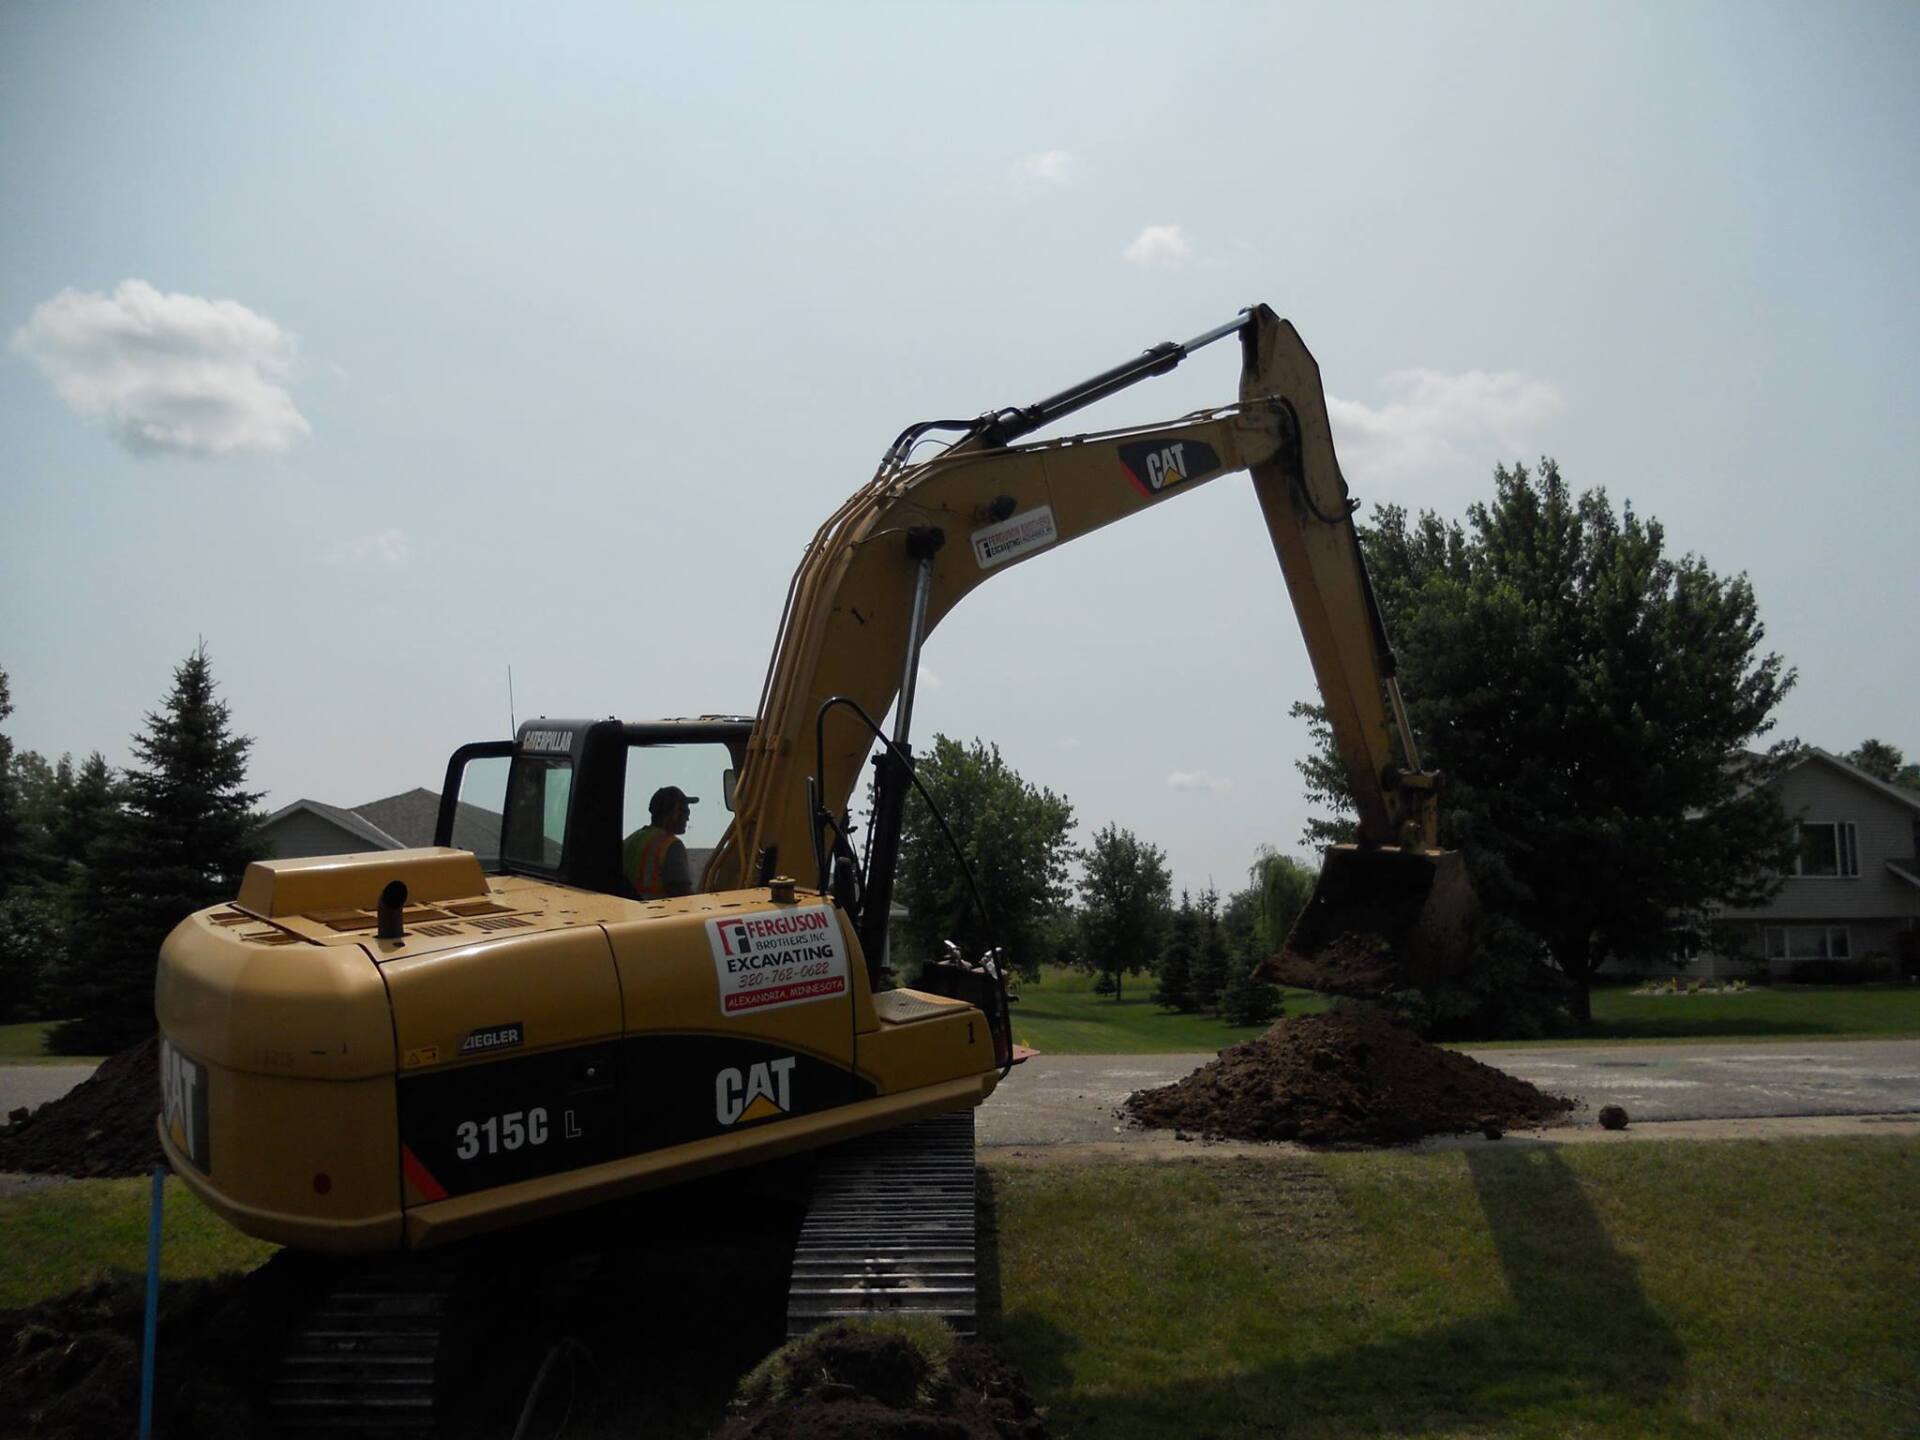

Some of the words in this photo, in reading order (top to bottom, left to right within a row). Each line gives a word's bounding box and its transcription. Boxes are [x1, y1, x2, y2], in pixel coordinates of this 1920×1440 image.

[1146, 443, 1187, 489] CAT
[523, 730, 573, 752] CATERPILLAR
[746, 911, 828, 938] FERGUSON
[727, 944, 834, 973] EXCAVATING
[738, 961, 830, 989] 320-762-0622
[790, 980, 844, 998] MINNESOTA
[462, 1028, 519, 1050] ZIEGLER
[716, 1056, 796, 1125] CAT
[456, 1107, 548, 1160] 315C
[564, 1110, 582, 1139] L
